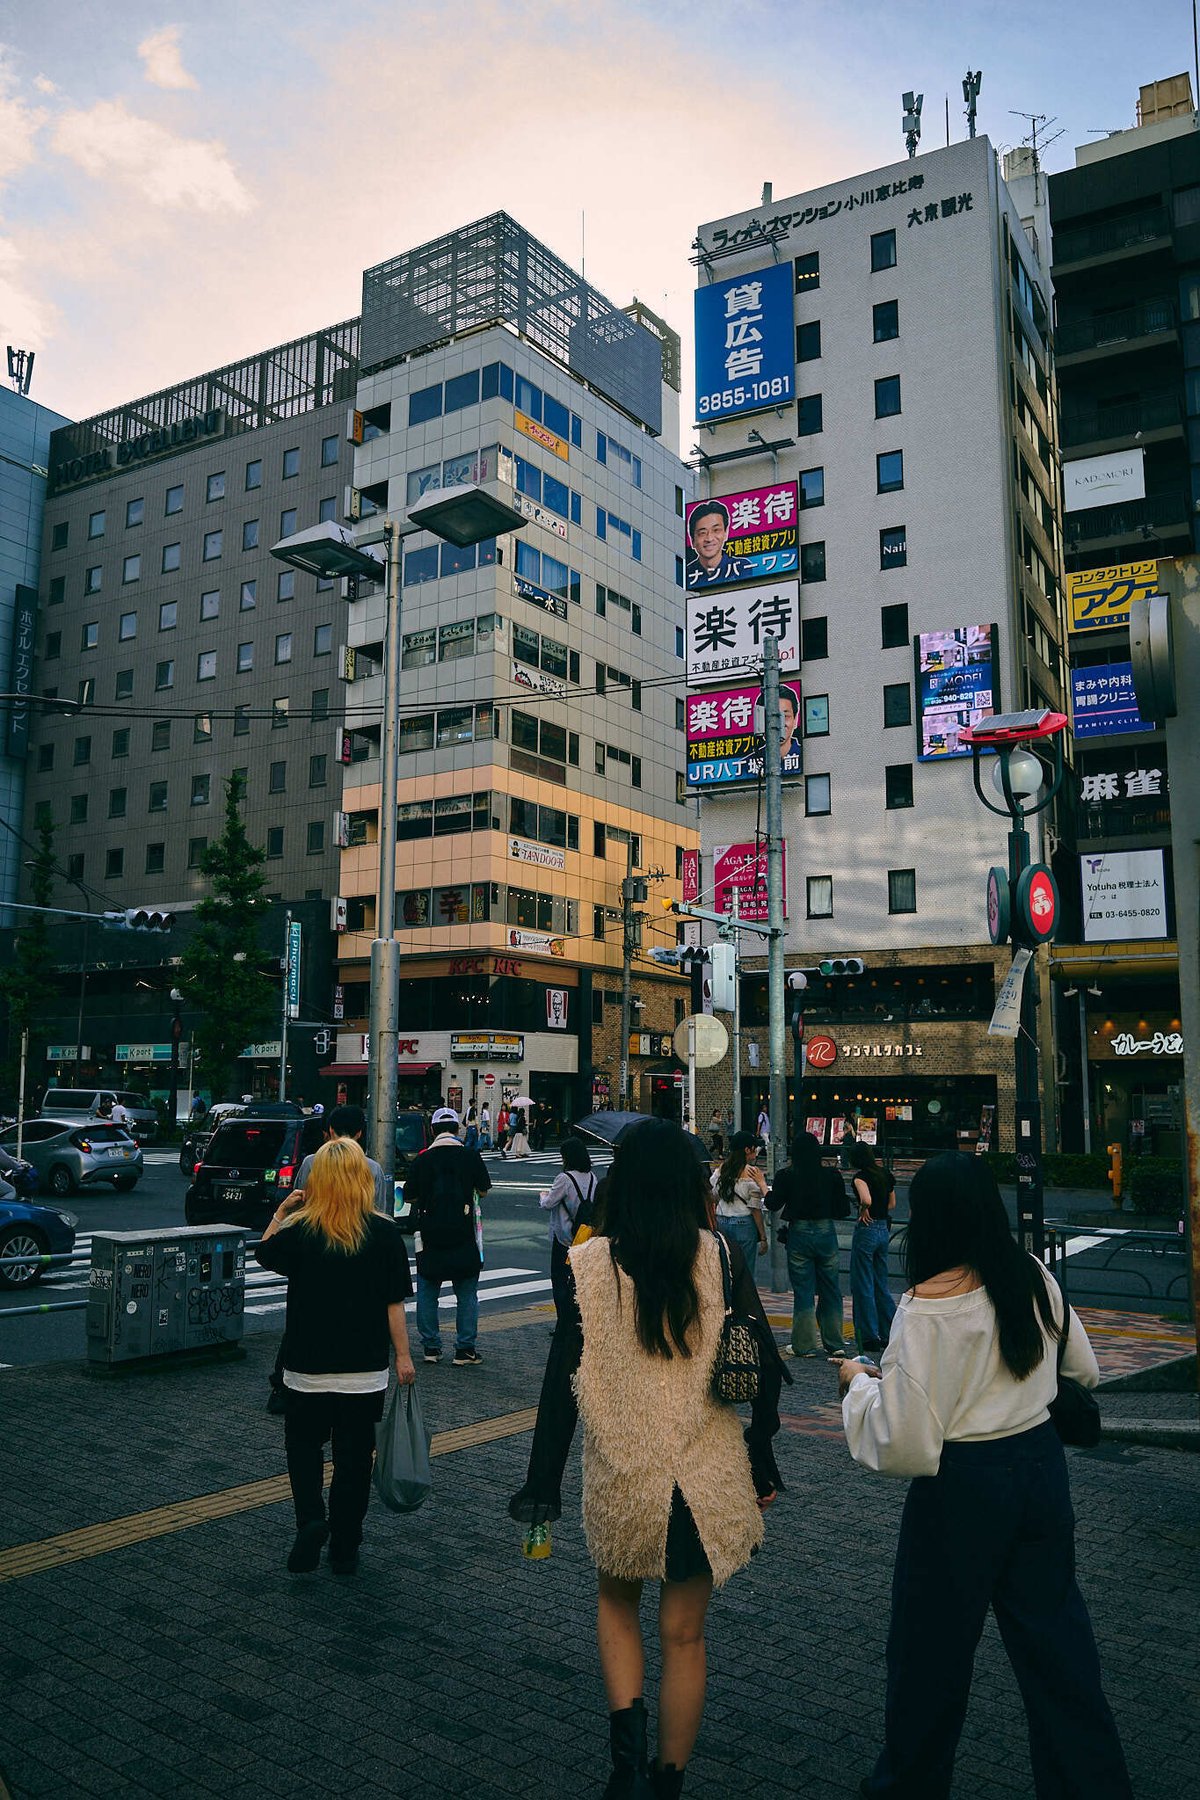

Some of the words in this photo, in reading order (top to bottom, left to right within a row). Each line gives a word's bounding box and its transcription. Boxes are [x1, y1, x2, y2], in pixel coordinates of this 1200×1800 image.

[723, 281, 764, 381] 貸広告
[699, 375, 790, 414] 3855-1081
[731, 490, 795, 530] 楽待
[725, 529, 796, 557] 不動産投資アプリ
[883, 541, 906, 555] Nail
[688, 553, 796, 585] ナンバーワン
[1073, 563, 1154, 585] コンタクトレン
[693, 595, 792, 654] 楽待
[1075, 674, 1132, 692] まみや内科
[689, 695, 753, 733] 楽待
[1080, 768, 1169, 801] 麻雀
[722, 855, 743, 866] AGA
[688, 857, 697, 889] AGA
[1087, 882, 1117, 891] Yotuha
[1105, 908, 1160, 919] 03-6455-0820
[493, 958, 523, 977] KFC
[397, 1039, 419, 1055] FC
[842, 1044, 923, 1057] サンマルクカフェ
[1111, 1032, 1184, 1055] カレーうど
